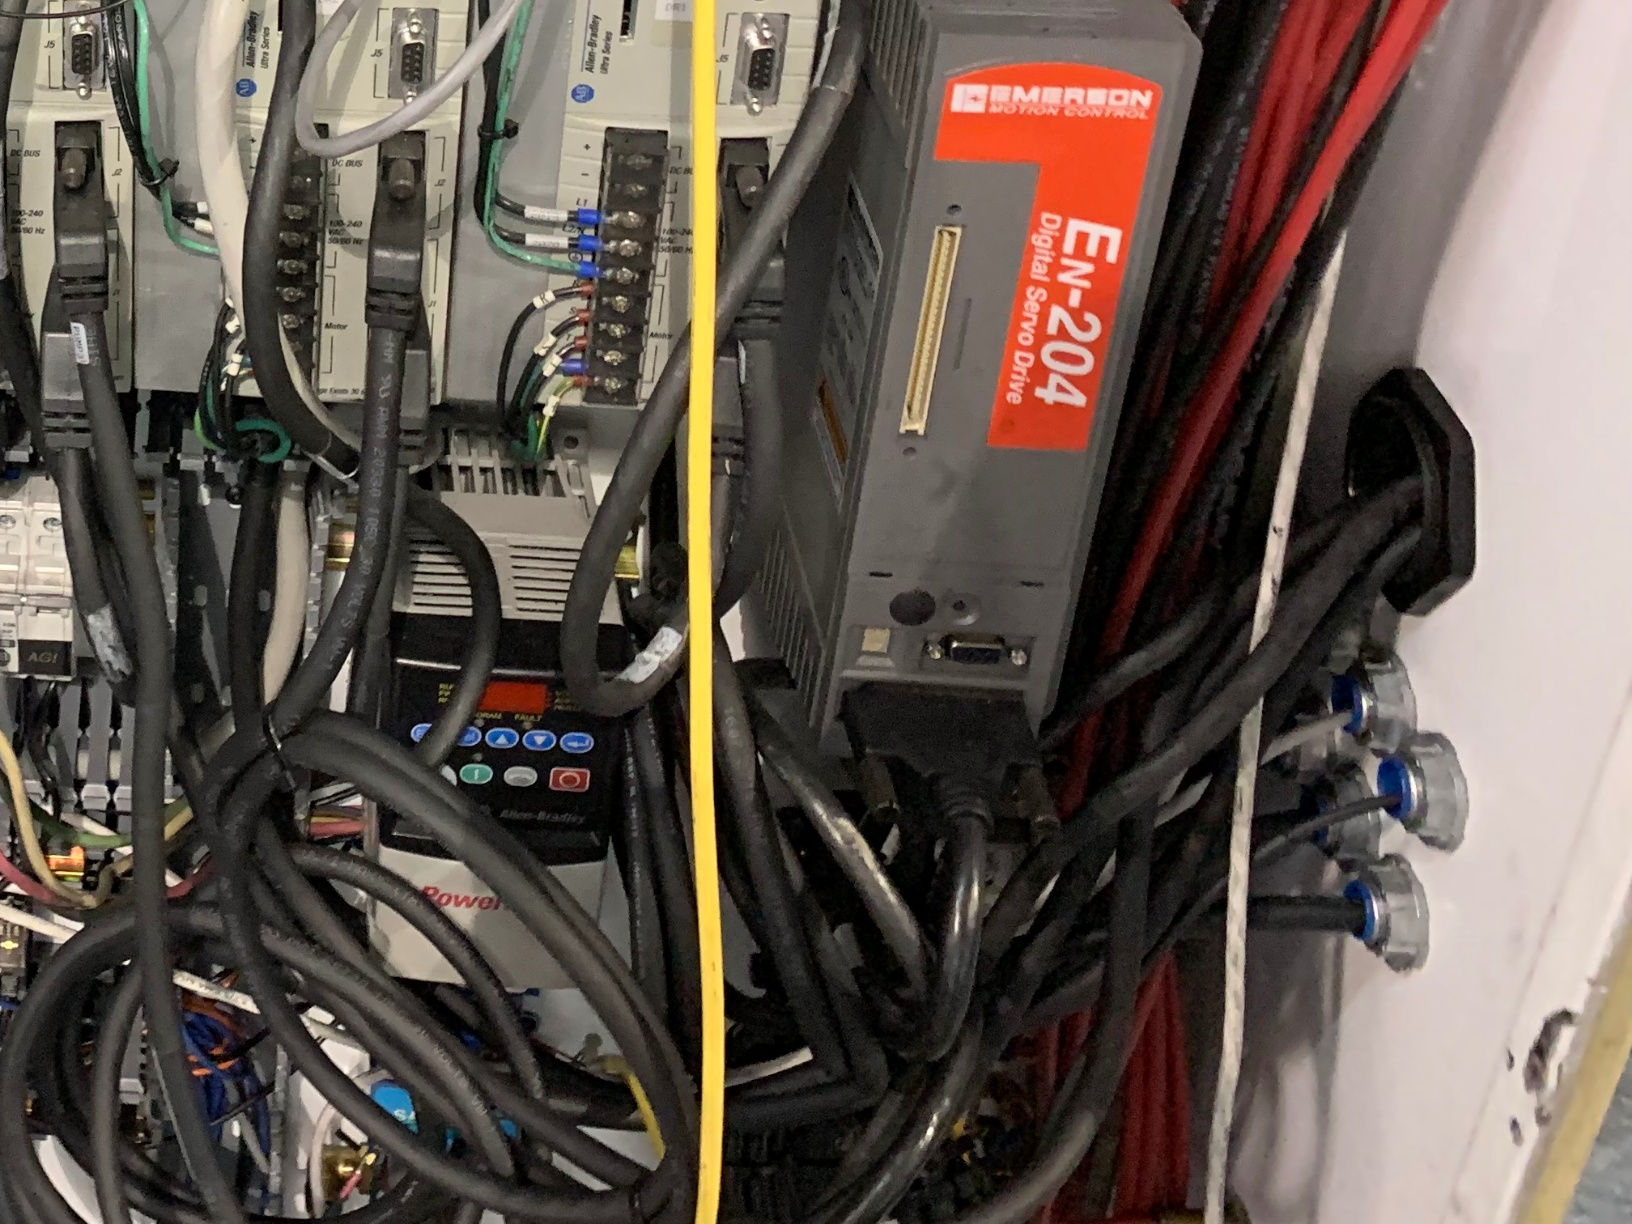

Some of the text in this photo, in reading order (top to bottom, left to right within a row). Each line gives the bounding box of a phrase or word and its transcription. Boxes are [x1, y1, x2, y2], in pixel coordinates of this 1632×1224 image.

[245, 10, 259, 68] Allen-Bradley
[44, 40, 55, 48] J5
[260, 26, 270, 69] Ultra Series
[584, 14, 602, 74] Allen-Bradley
[371, 48, 383, 57] J5
[600, 31, 613, 74] Ultra Series
[715, 54, 729, 62] J5
[989, 84, 1154, 109] EMERSON
[988, 103, 1149, 120] MOTION CONTROL
[10, 149, 40, 158] DC BUS
[332, 159, 363, 168] DC BUS
[112, 168, 123, 176] J2
[669, 167, 681, 175] DC
[434, 178, 446, 186] J2
[576, 198, 587, 206] L1
[329, 219, 363, 228] 100-240
[35, 227, 46, 235] Hz
[328, 228, 344, 236] VAC
[428, 299, 436, 307] J1
[1006, 211, 1063, 406] Digital Servo Drive
[1035, 217, 1123, 408] EN-204
[324, 322, 347, 330] Motor
[649, 332, 673, 340] Motor
[500, 809, 586, 825] Allen-Bradley
